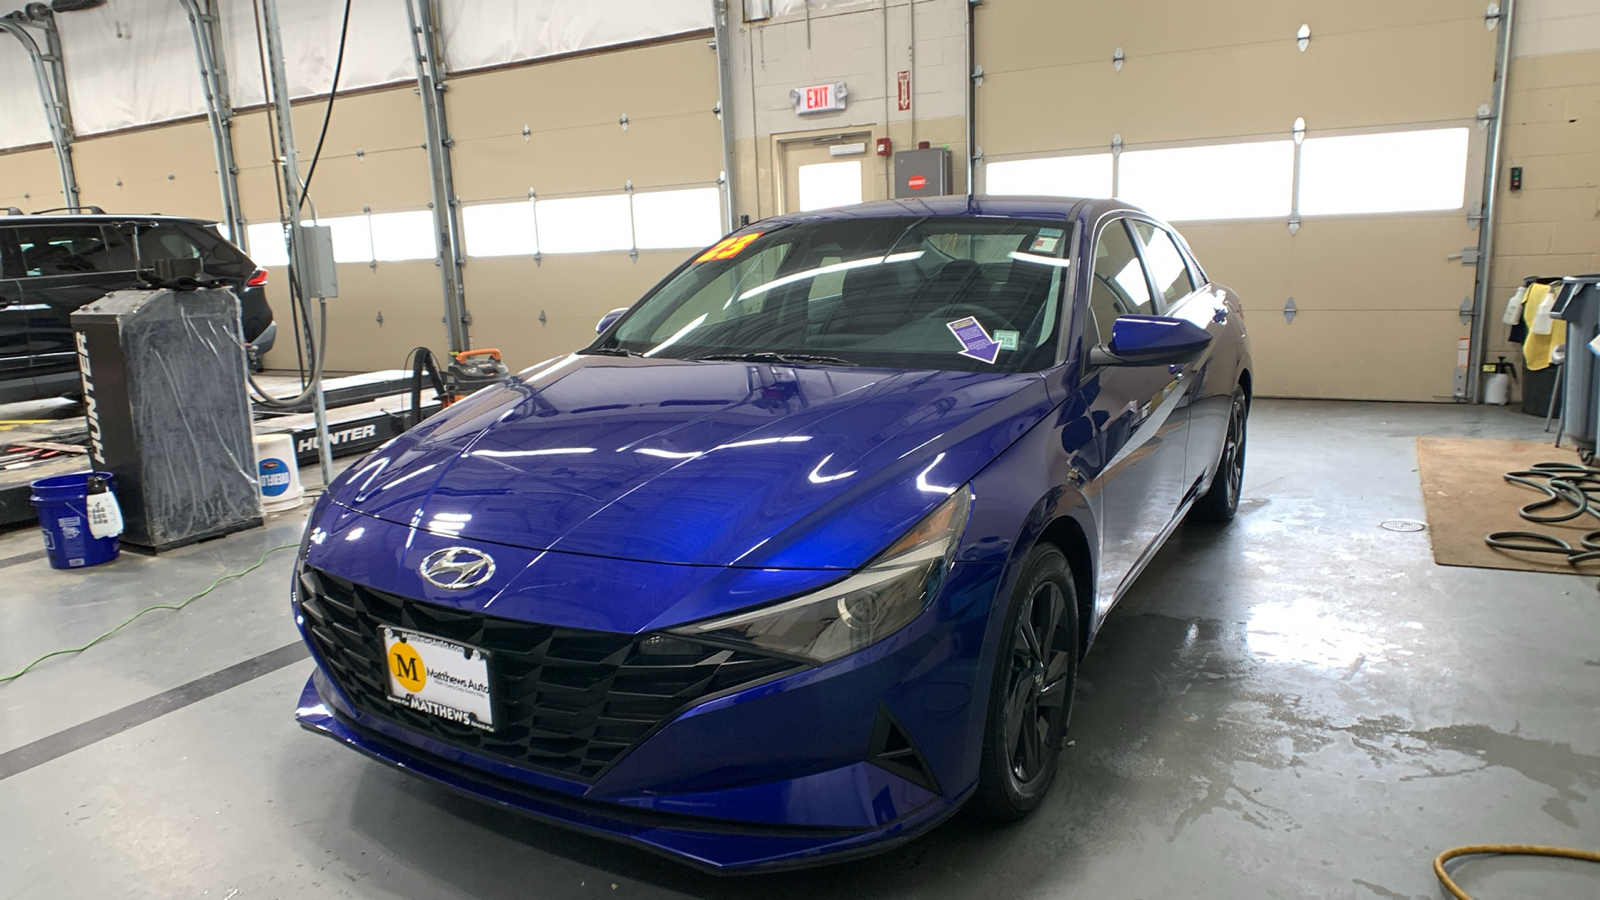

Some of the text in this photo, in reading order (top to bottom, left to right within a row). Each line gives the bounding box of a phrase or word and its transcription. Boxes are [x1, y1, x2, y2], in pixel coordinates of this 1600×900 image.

[807, 87, 829, 109] EXIT
[695, 232, 760, 262] 23
[76, 331, 105, 464] HUNTER
[297, 424, 377, 453] HUNTER
[393, 653, 421, 683] M
[426, 666, 490, 694] Matthews Auto
[410, 697, 471, 726] MATTHEWS
